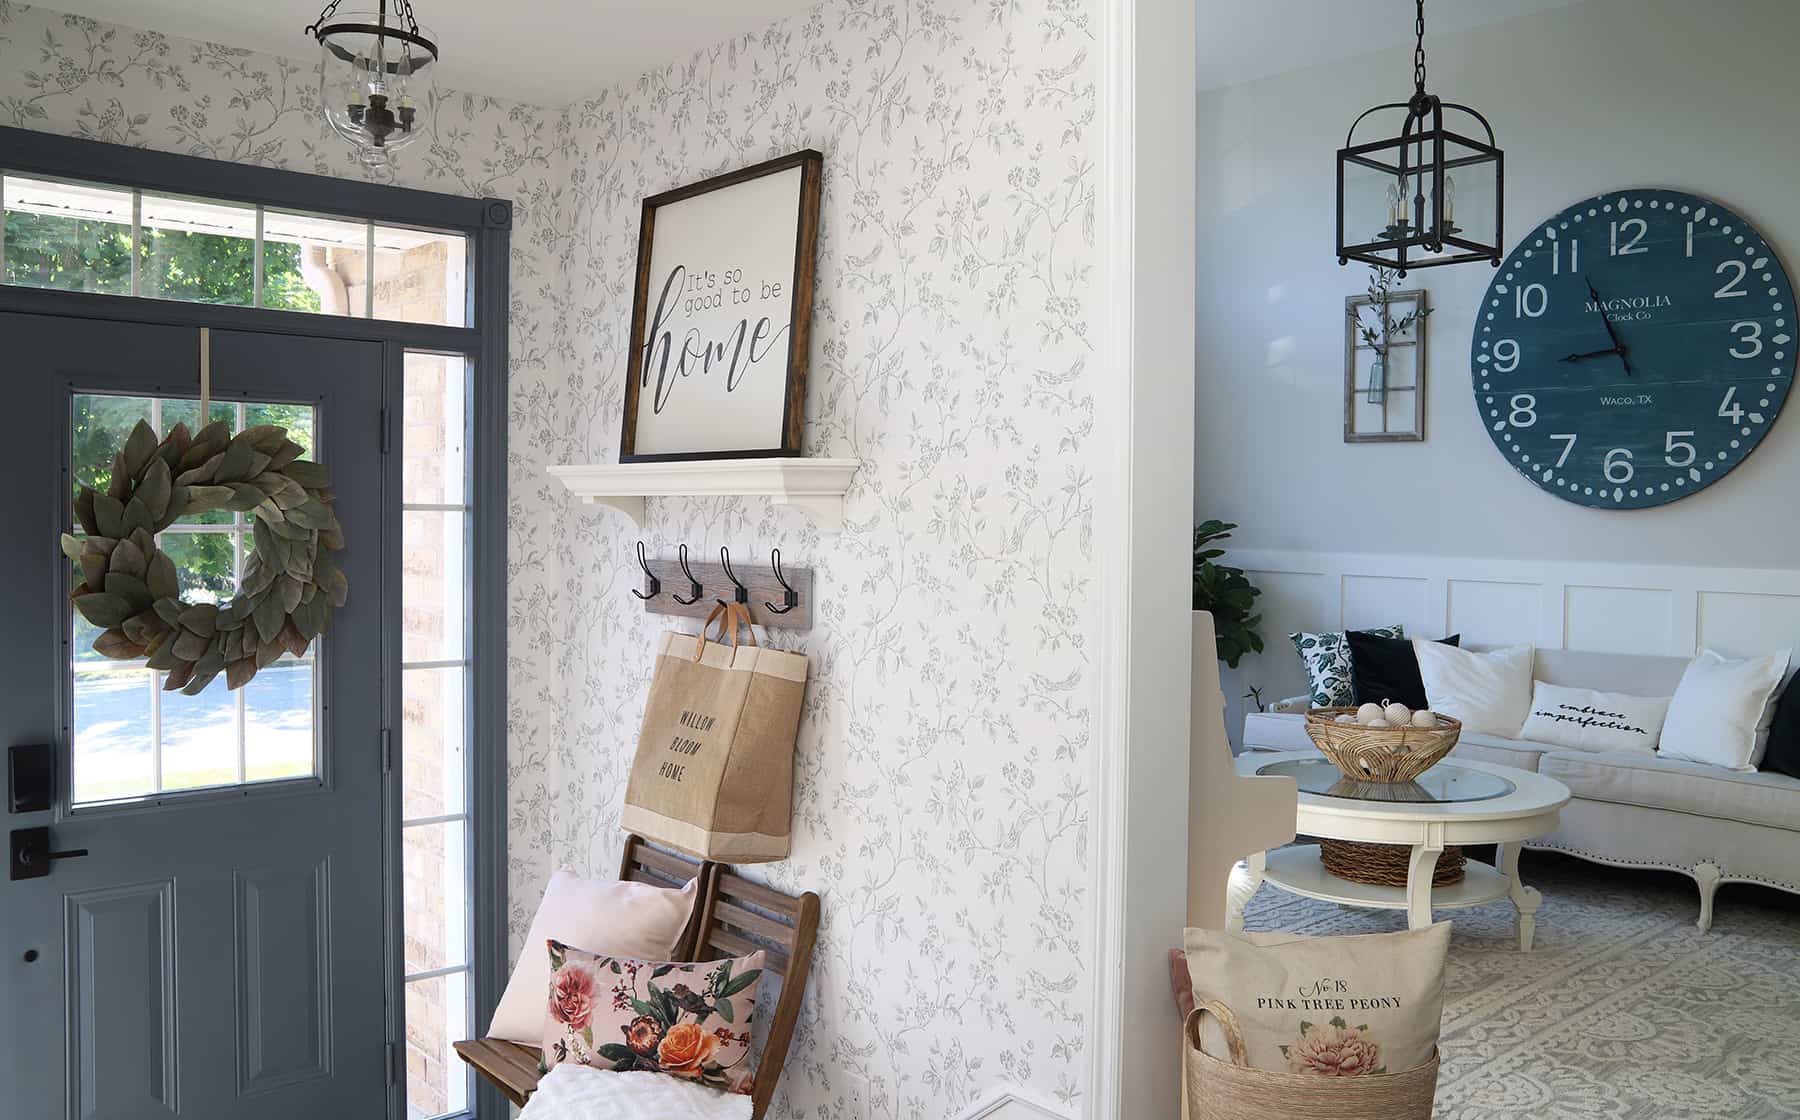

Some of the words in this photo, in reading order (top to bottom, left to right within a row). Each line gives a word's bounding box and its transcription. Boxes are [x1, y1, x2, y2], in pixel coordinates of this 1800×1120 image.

[1610, 218, 1649, 256] 12
[1686, 222, 1693, 257] 1
[1552, 238, 1578, 275] 11
[687, 270, 716, 292] It's
[723, 268, 743, 286] so
[1713, 260, 1748, 299] 2
[684, 288, 723, 318] good
[732, 287, 751, 305] to
[760, 280, 782, 300] be
[1514, 283, 1549, 319] 10
[1584, 295, 1673, 313] MAGNOLIA
[1606, 312, 1634, 321] Clock
[1635, 311, 1652, 321] Co
[641, 264, 792, 415] home
[1492, 338, 1521, 372] 9
[1728, 320, 1764, 359] 3
[1508, 393, 1538, 428] 8
[1637, 394, 1653, 404] TX
[1717, 386, 1745, 424] 4
[1549, 433, 1577, 468] 7
[1602, 448, 1635, 484] 6
[1663, 430, 1697, 467] 5
[679, 710, 716, 733] WILLOW
[1535, 710, 1648, 735] imperfection
[1559, 704, 1627, 719] embrace
[669, 736, 702, 756] BLOOM
[658, 761, 686, 782] HOME
[1256, 998, 1297, 1009] PINK
[1300, 998, 1345, 1010] TREE
[1350, 997, 1401, 1009] PEONY
[1335, 979, 1348, 993] 18
